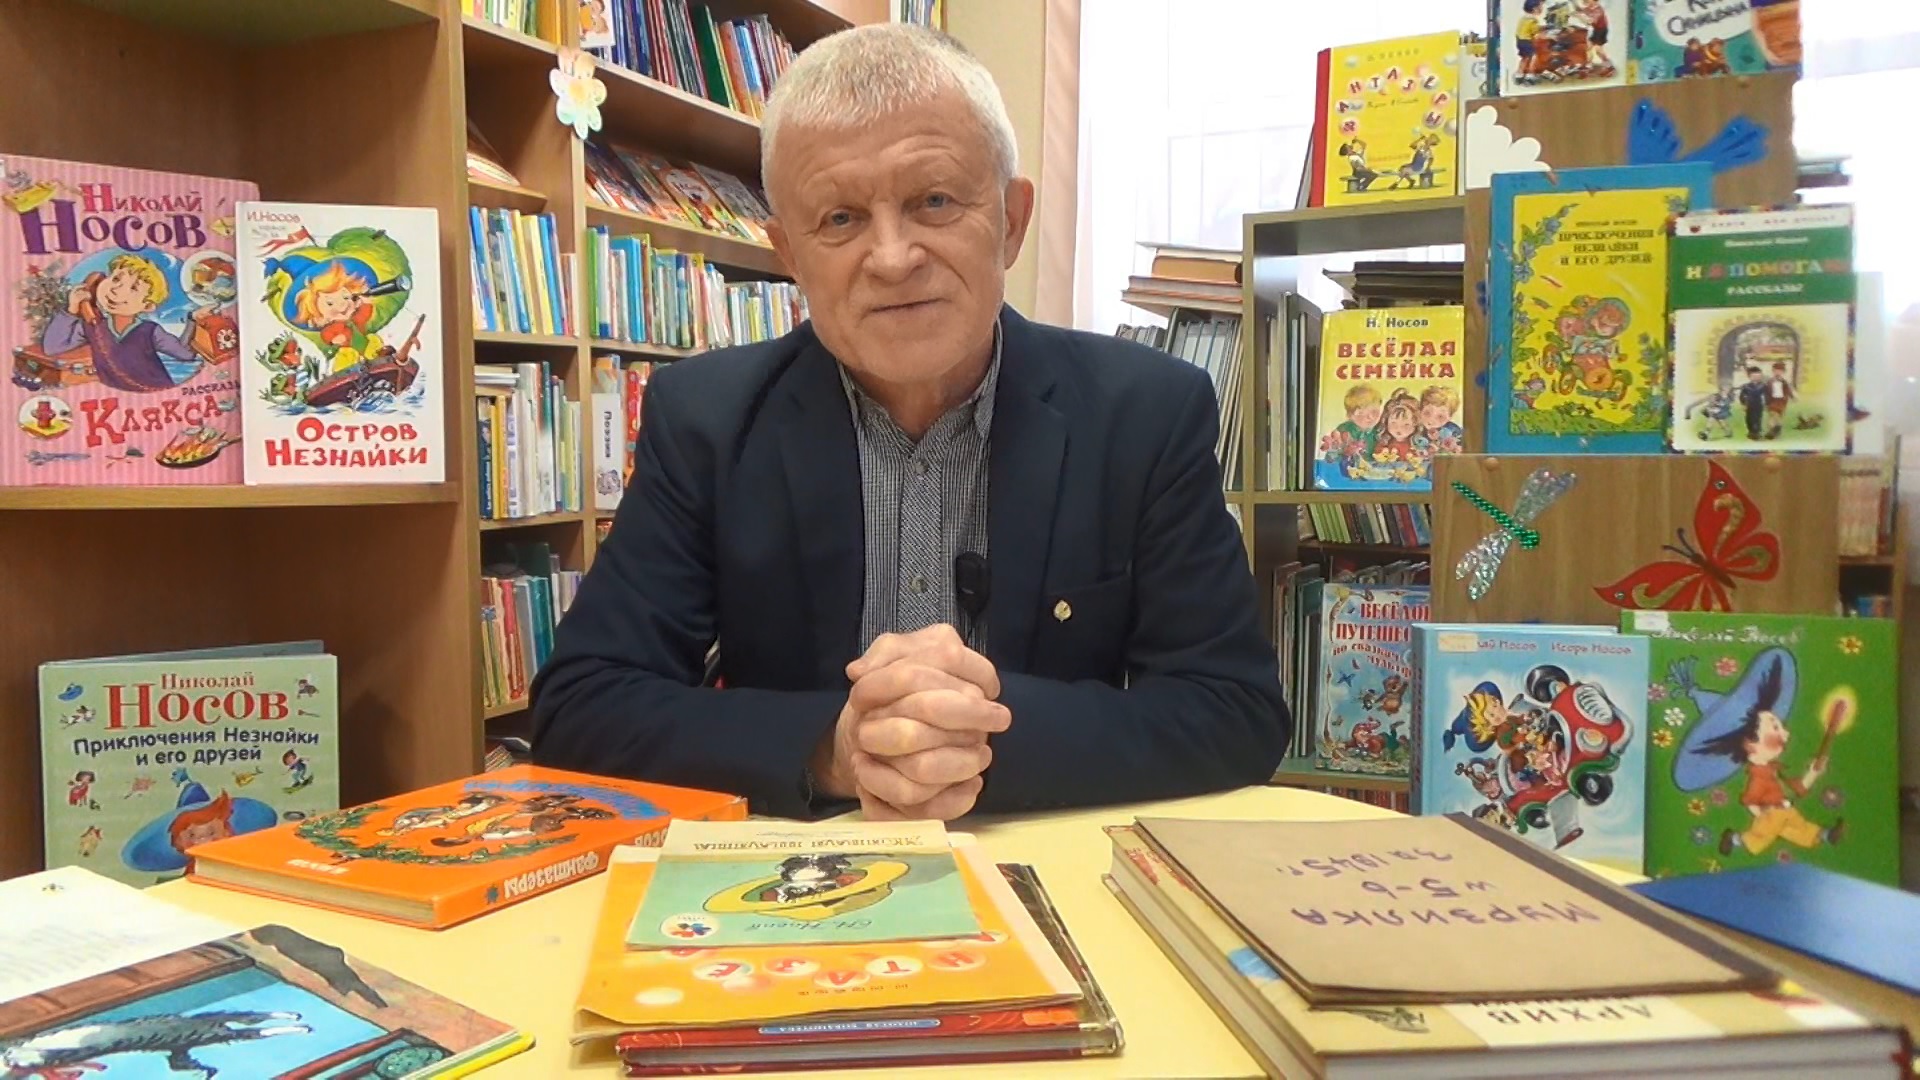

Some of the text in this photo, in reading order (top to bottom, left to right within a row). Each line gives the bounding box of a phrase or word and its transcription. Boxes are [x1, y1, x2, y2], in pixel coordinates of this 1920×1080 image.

[1366, 317, 1429, 328] Н. Носов
[1337, 338, 1456, 359] ВЕСЁЛАЯ
[1335, 358, 1456, 380] СЕМЕЙКА
[161, 672, 255, 690] Николай
[74, 727, 319, 757] Приключения Незнайки
[136, 745, 261, 766] и его друзей
[1487, 1005, 1653, 1025] АРХИВ
